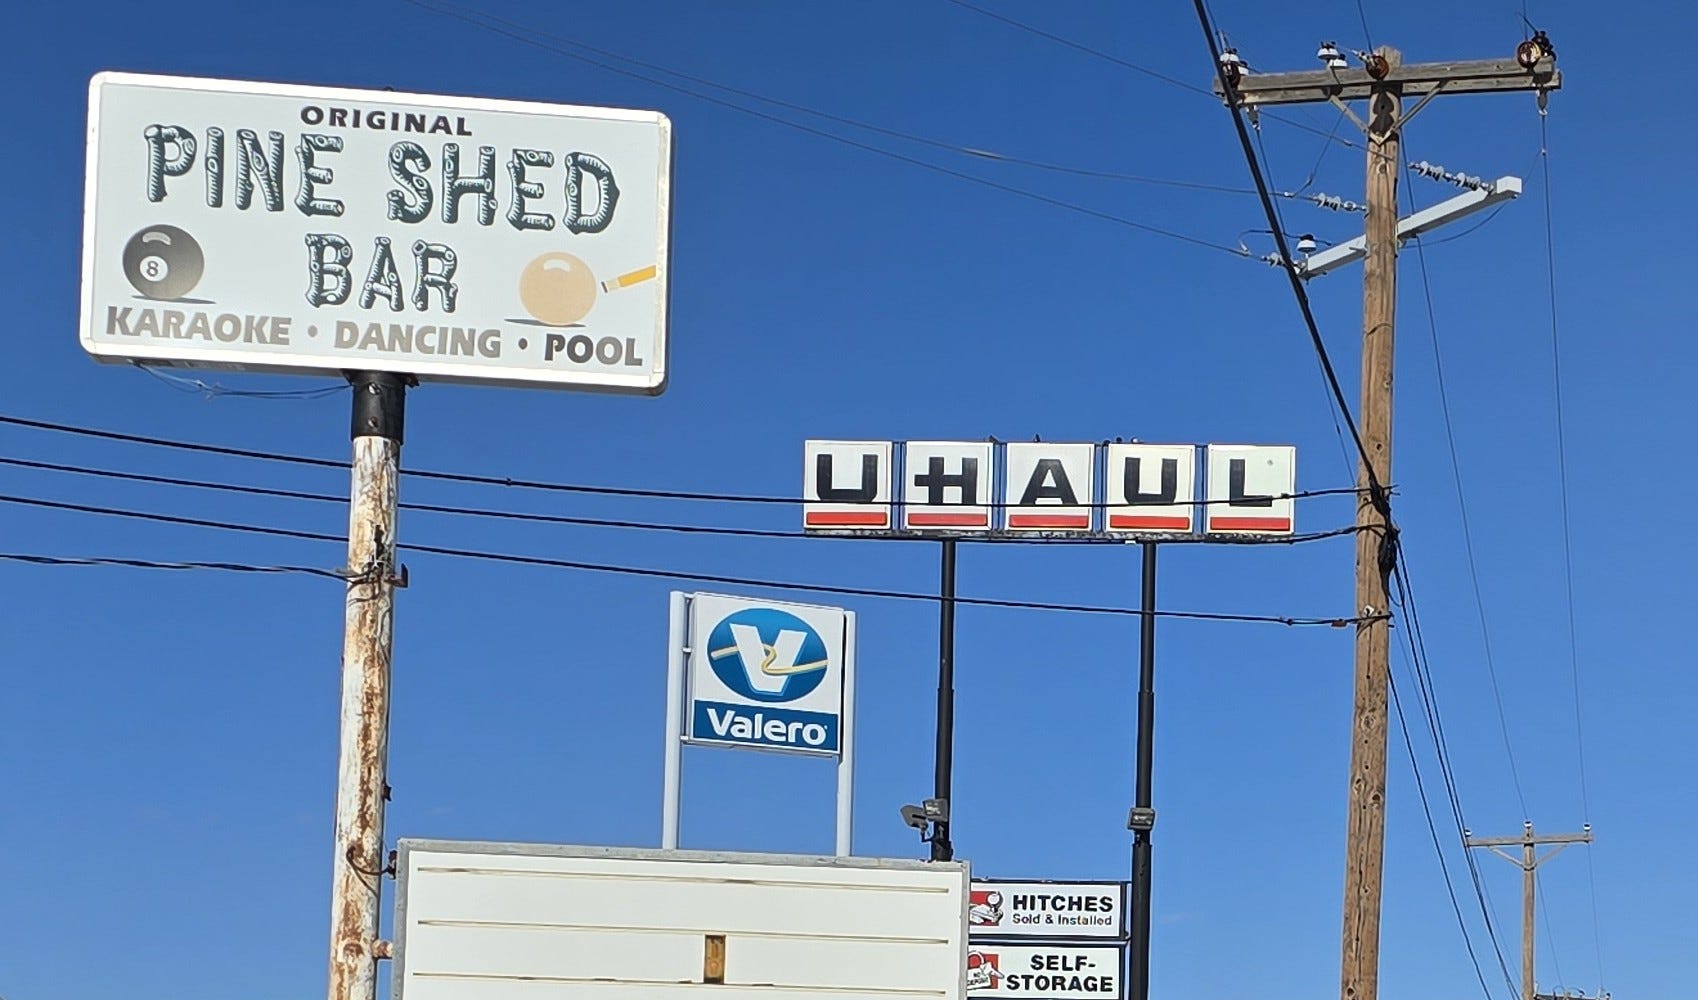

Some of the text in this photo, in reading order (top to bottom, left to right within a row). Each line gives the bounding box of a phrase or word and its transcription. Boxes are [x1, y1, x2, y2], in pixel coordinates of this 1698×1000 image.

[301, 105, 473, 137] ORIGINAL
[143, 124, 620, 235] PINE SHED
[303, 233, 459, 313] BAR
[105, 305, 644, 367] KARAOKE DANCING POOL
[706, 708, 828, 746] Valero
[1012, 895, 1113, 912] HITCHES
[1012, 914, 1113, 926] Sold & Installed
[1030, 954, 1096, 971] SELF-
[1006, 974, 1113, 992] STORAGE
